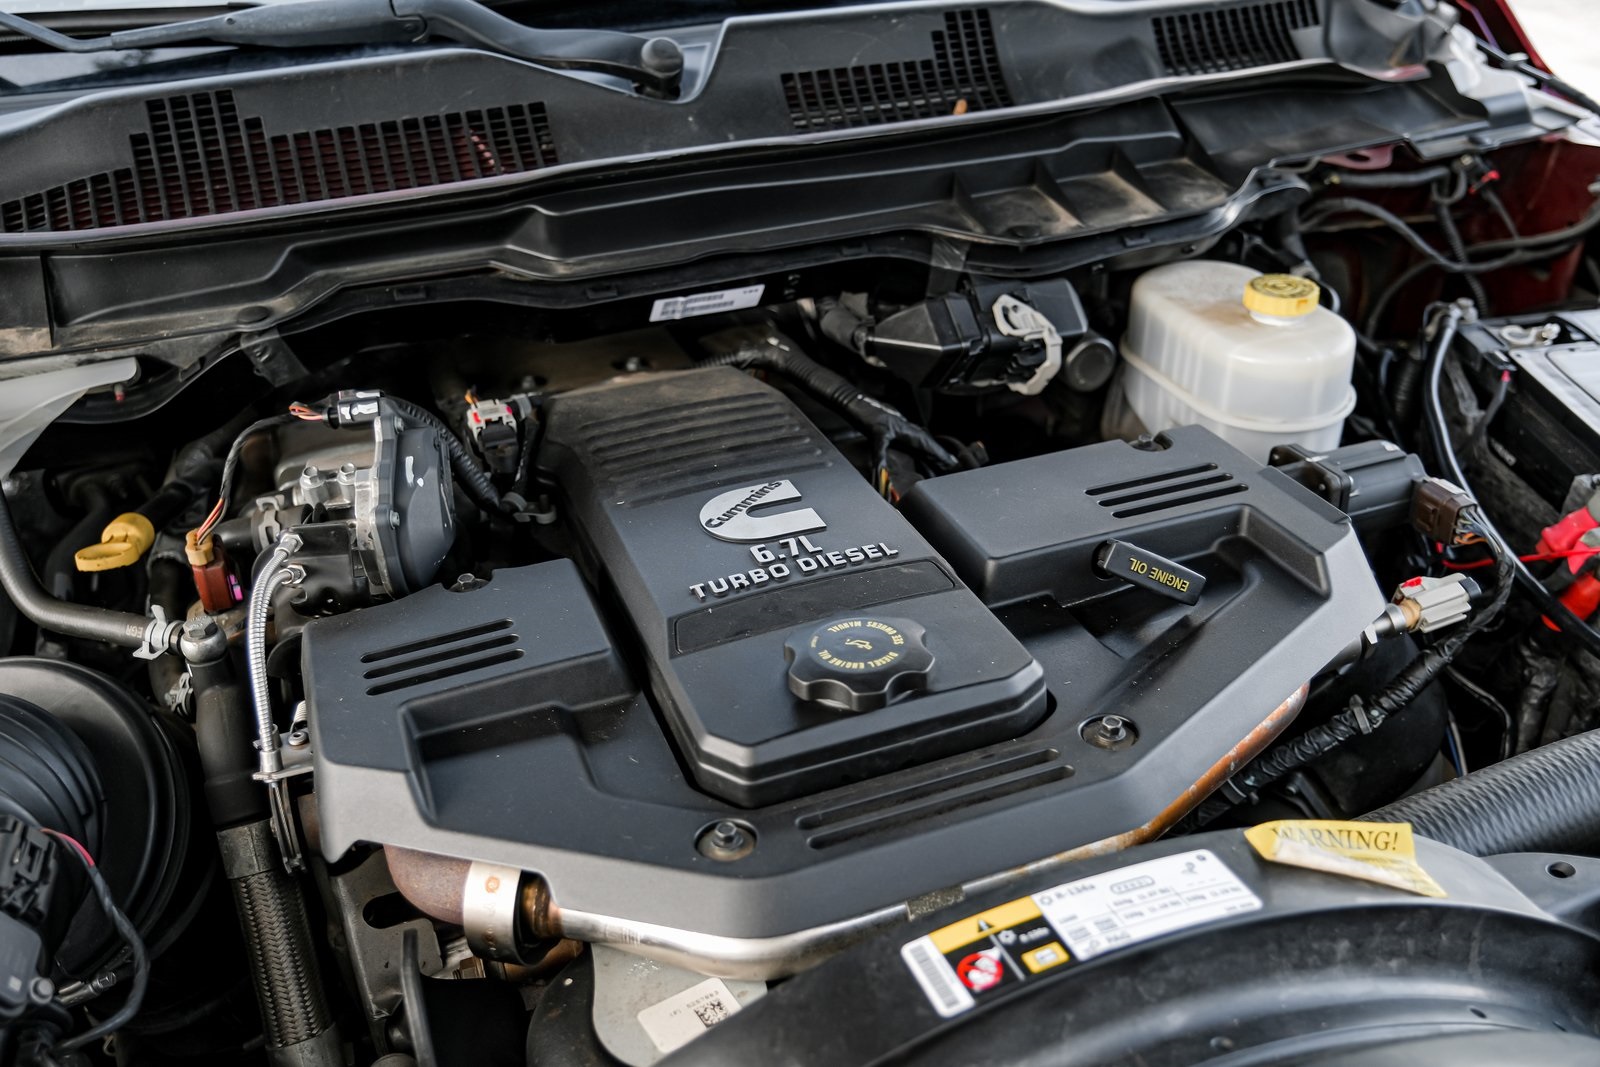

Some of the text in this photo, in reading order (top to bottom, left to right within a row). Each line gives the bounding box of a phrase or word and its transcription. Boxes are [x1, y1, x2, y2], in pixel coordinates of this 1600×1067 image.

[704, 480, 783, 529] Cummins
[750, 535, 823, 565] 6.7L
[689, 542, 899, 600] TURBO DIESEL
[1129, 557, 1190, 592] ENGINE OIL
[1272, 828, 1399, 852] WARNING!
